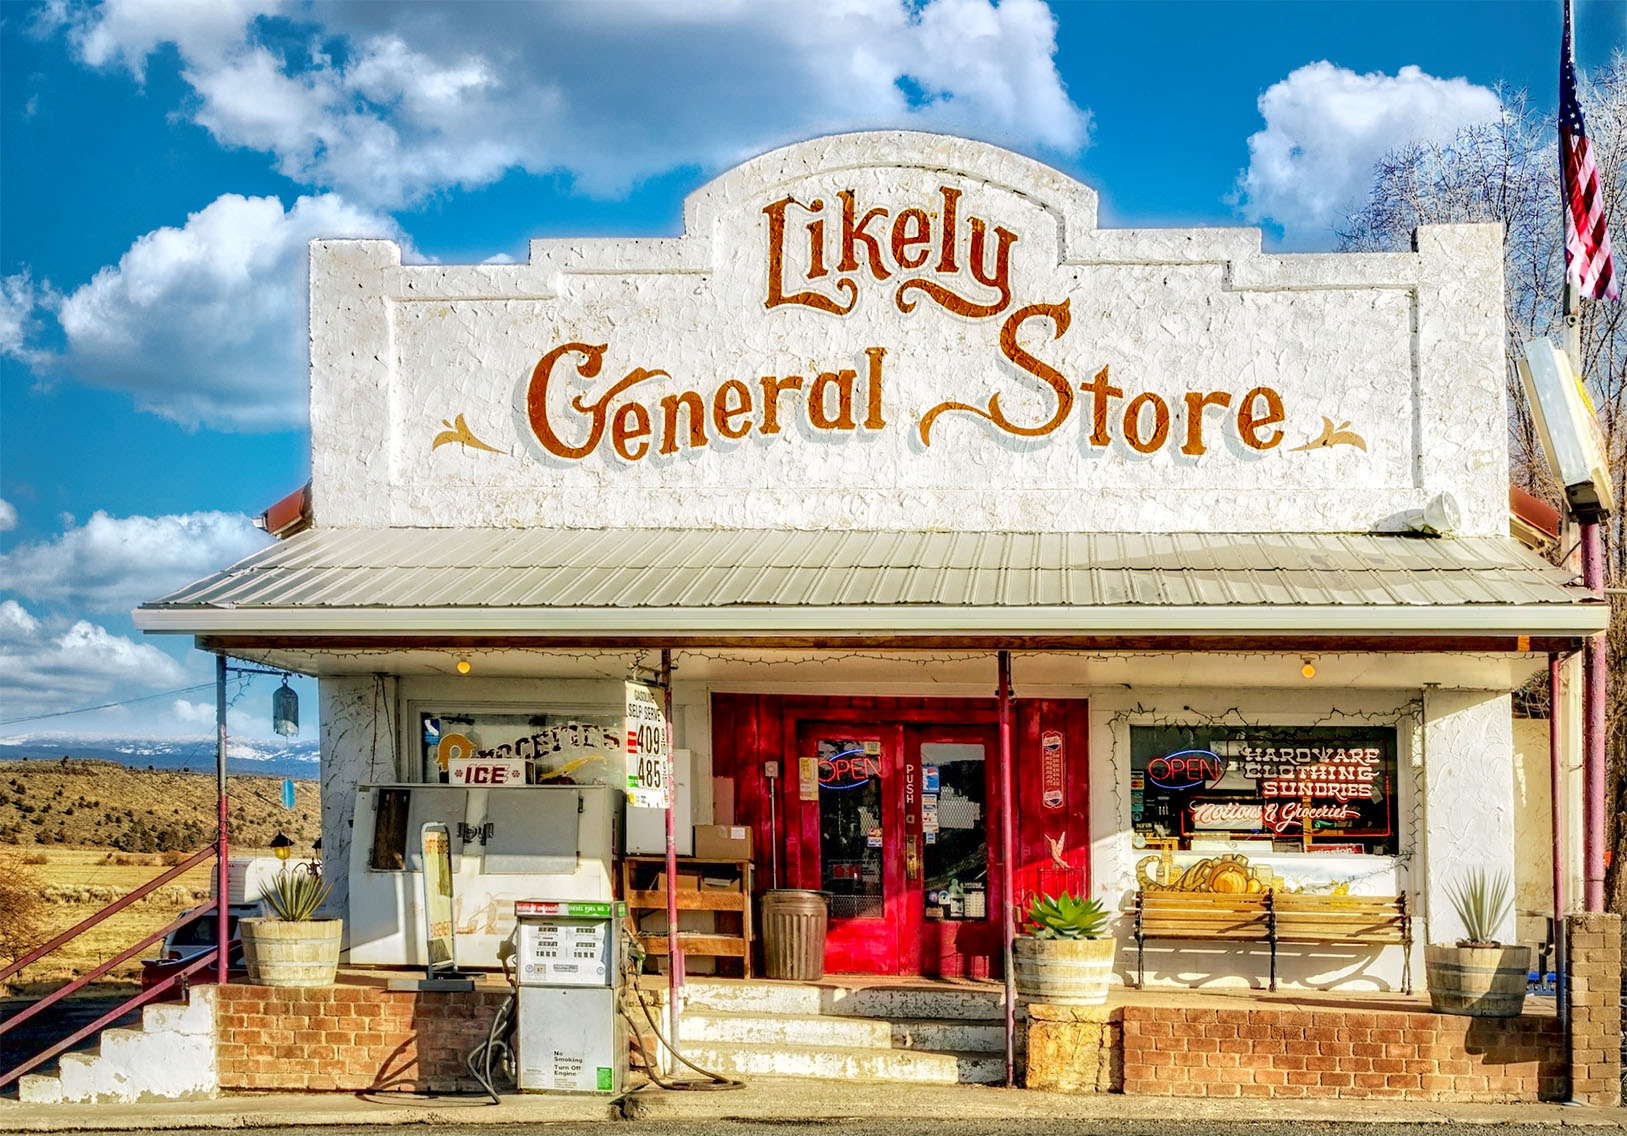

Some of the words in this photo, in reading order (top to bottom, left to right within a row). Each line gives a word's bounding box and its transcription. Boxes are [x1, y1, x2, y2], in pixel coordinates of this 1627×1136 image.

[761, 185, 1020, 318] Likely
[526, 341, 888, 462] General
[919, 298, 1286, 456] Store
[637, 724, 660, 754] 409
[818, 756, 888, 783] OPEN
[1147, 757, 1219, 781] OPEN
[1241, 745, 1380, 766] HARDWARE
[465, 764, 510, 784] ICE
[638, 757, 661, 788] 485
[906, 764, 914, 804] PUSH
[1244, 764, 1380, 781] CLOTHING
[1262, 781, 1374, 801] SUNDRIES
[1188, 800, 1263, 825] Notions
[1277, 801, 1362, 833] Groceries
